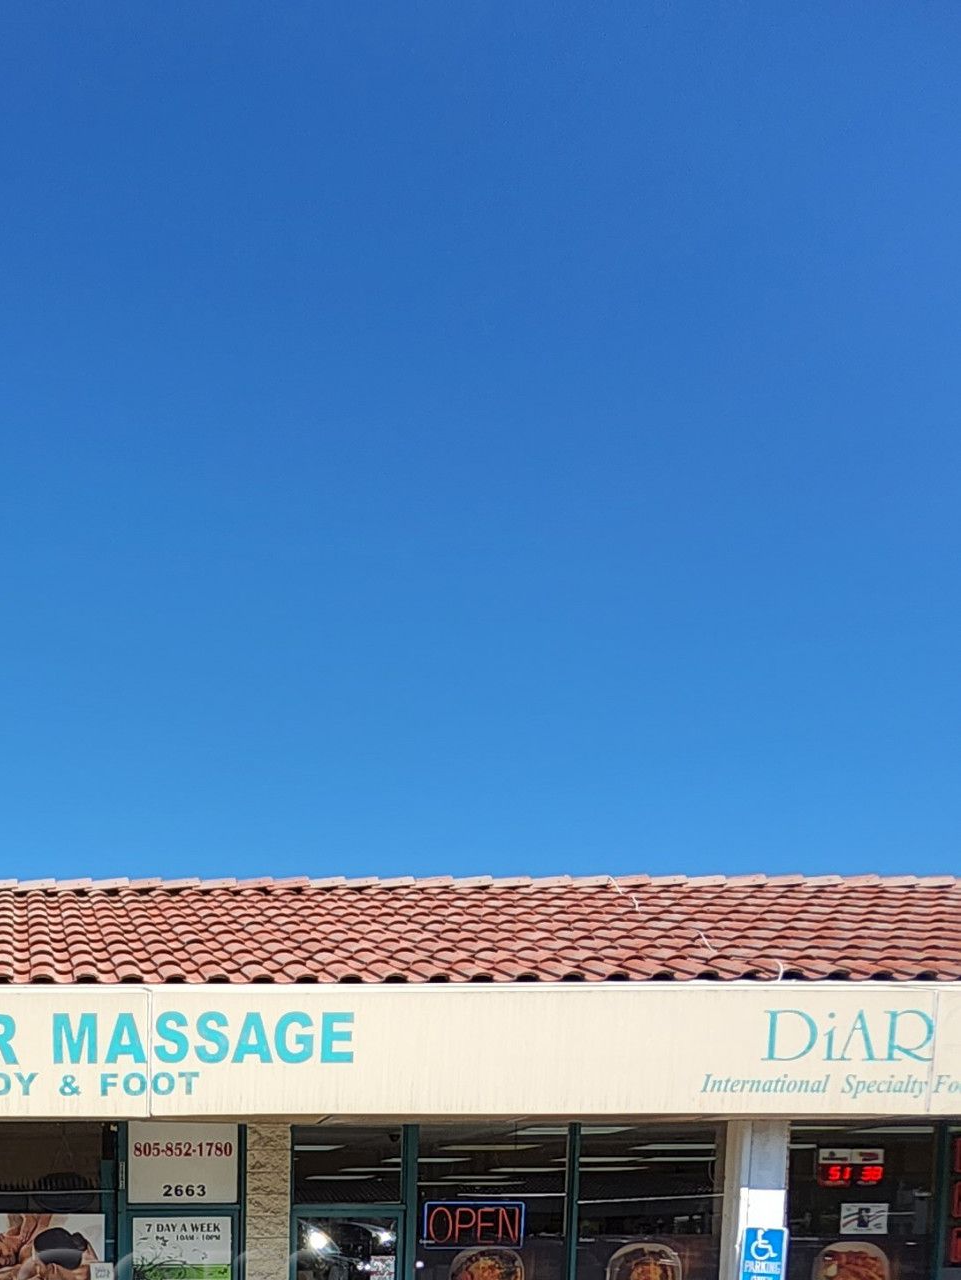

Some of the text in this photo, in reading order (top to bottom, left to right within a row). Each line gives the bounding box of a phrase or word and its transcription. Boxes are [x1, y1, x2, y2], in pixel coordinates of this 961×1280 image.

[53, 1011, 355, 1064] MASSAGE
[59, 1074, 82, 1097] &
[100, 1071, 199, 1097] FOOT
[700, 1073, 961, 1099] International Specialty Fo
[133, 1141, 233, 1158] 805-852-1780
[162, 1184, 206, 1197] 2663
[145, 1223, 221, 1233] 7 DAY A WEEK
[429, 1206, 520, 1244] OPEN
[743, 1260, 782, 1275] PARKING
